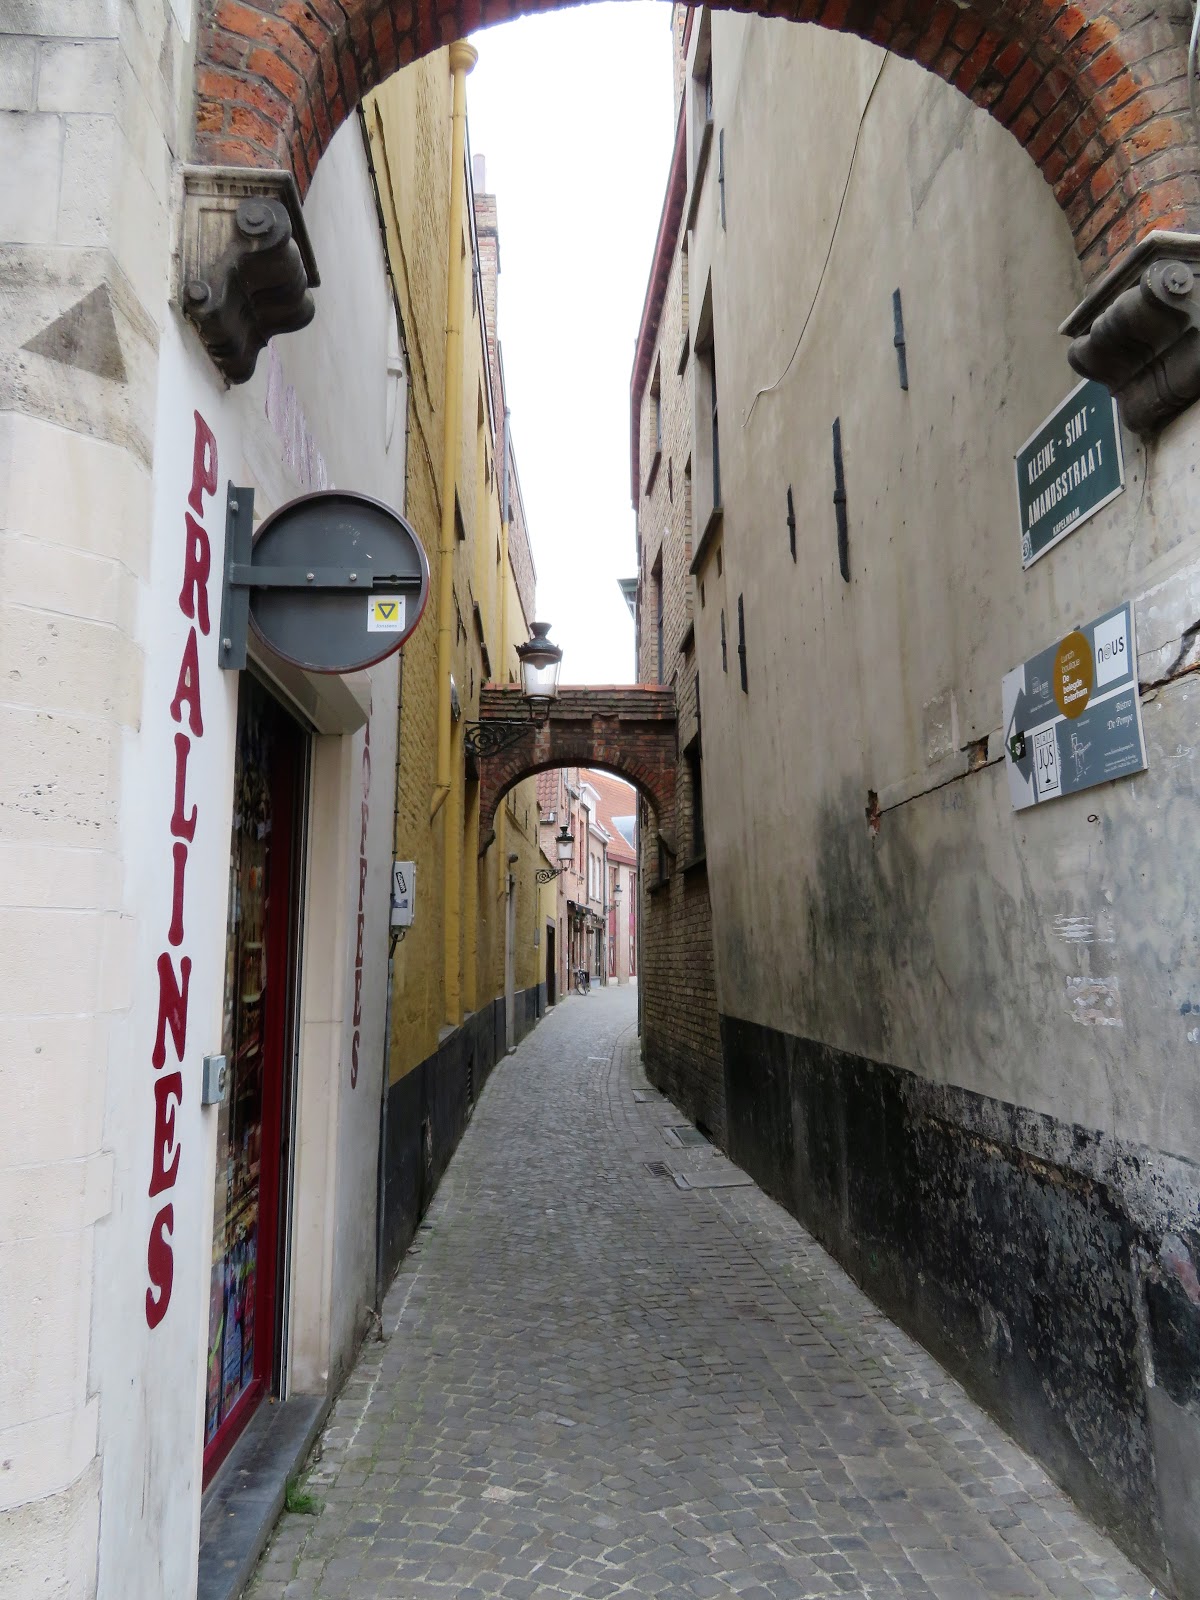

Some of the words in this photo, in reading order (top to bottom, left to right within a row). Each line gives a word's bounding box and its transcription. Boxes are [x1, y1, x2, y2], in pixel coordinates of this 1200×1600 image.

[1027, 438, 1056, 485] KLEINE
[1065, 405, 1088, 448] SINT
[1028, 439, 1103, 528] AMANDSSTRAAT
[1062, 675, 1070, 684] De
[1063, 687, 1088, 705] Boterham
[145, 408, 218, 1330] PRALINES
